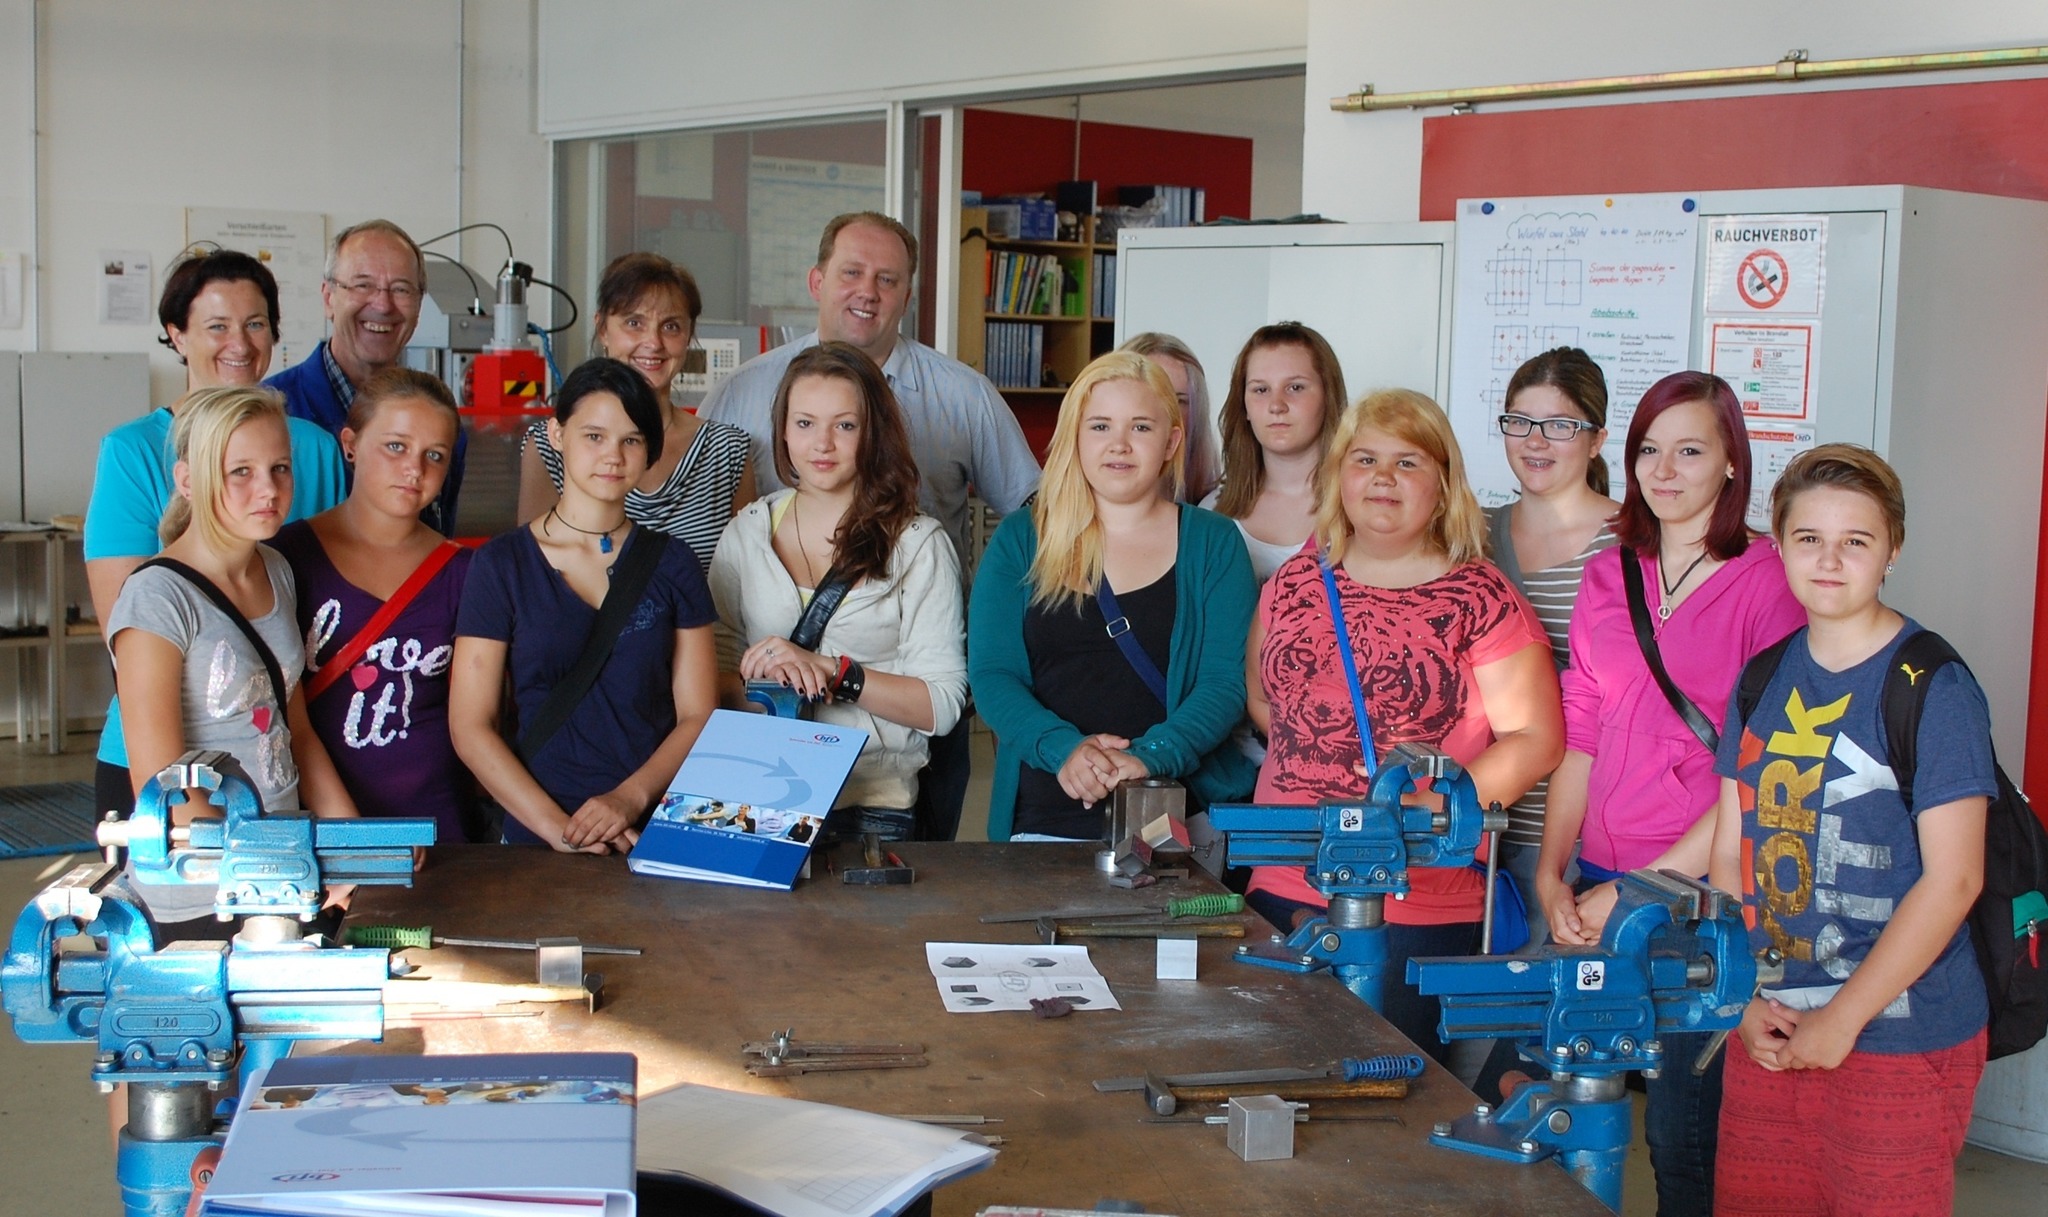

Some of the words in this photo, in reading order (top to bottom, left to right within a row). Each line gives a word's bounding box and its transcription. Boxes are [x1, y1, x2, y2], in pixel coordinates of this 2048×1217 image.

[1715, 228, 1817, 242] RAUCHVERBOT
[1656, 274, 1666, 285] 7
[306, 598, 454, 677] lve
[1343, 815, 1359, 828] GS
[1755, 686, 1852, 962] YORK
[1582, 970, 1600, 986] GS
[154, 1016, 180, 1028] 120
